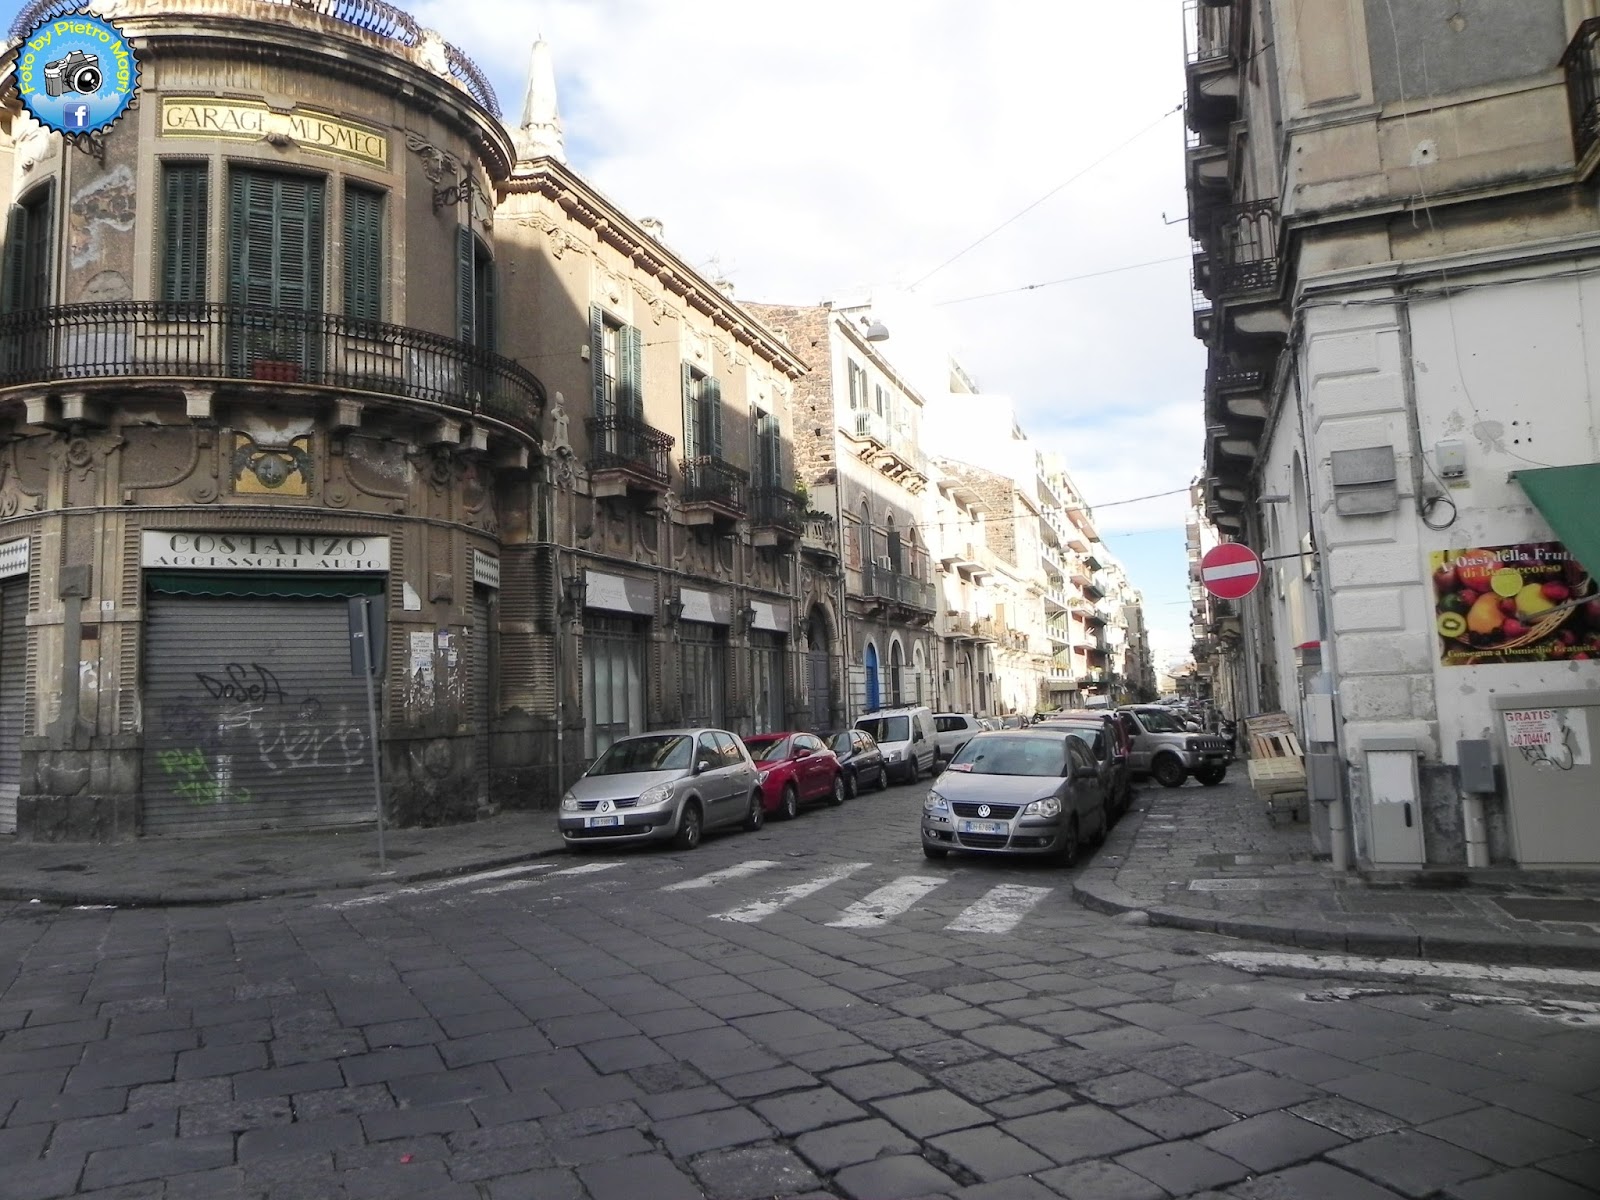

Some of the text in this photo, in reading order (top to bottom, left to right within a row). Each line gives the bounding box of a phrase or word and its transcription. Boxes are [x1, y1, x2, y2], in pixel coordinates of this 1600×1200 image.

[287, 116, 383, 159] MUSMECI
[169, 533, 367, 557] COSTANZO
[1494, 548, 1529, 562] della
[1534, 548, 1576, 561] Frutt
[153, 556, 381, 569] ACCESSORI AUTO
[1463, 567, 1475, 578] di
[1447, 649, 1493, 658] Consegna
[1504, 645, 1551, 656] Domicilio
[1505, 710, 1551, 721] GRATIS
